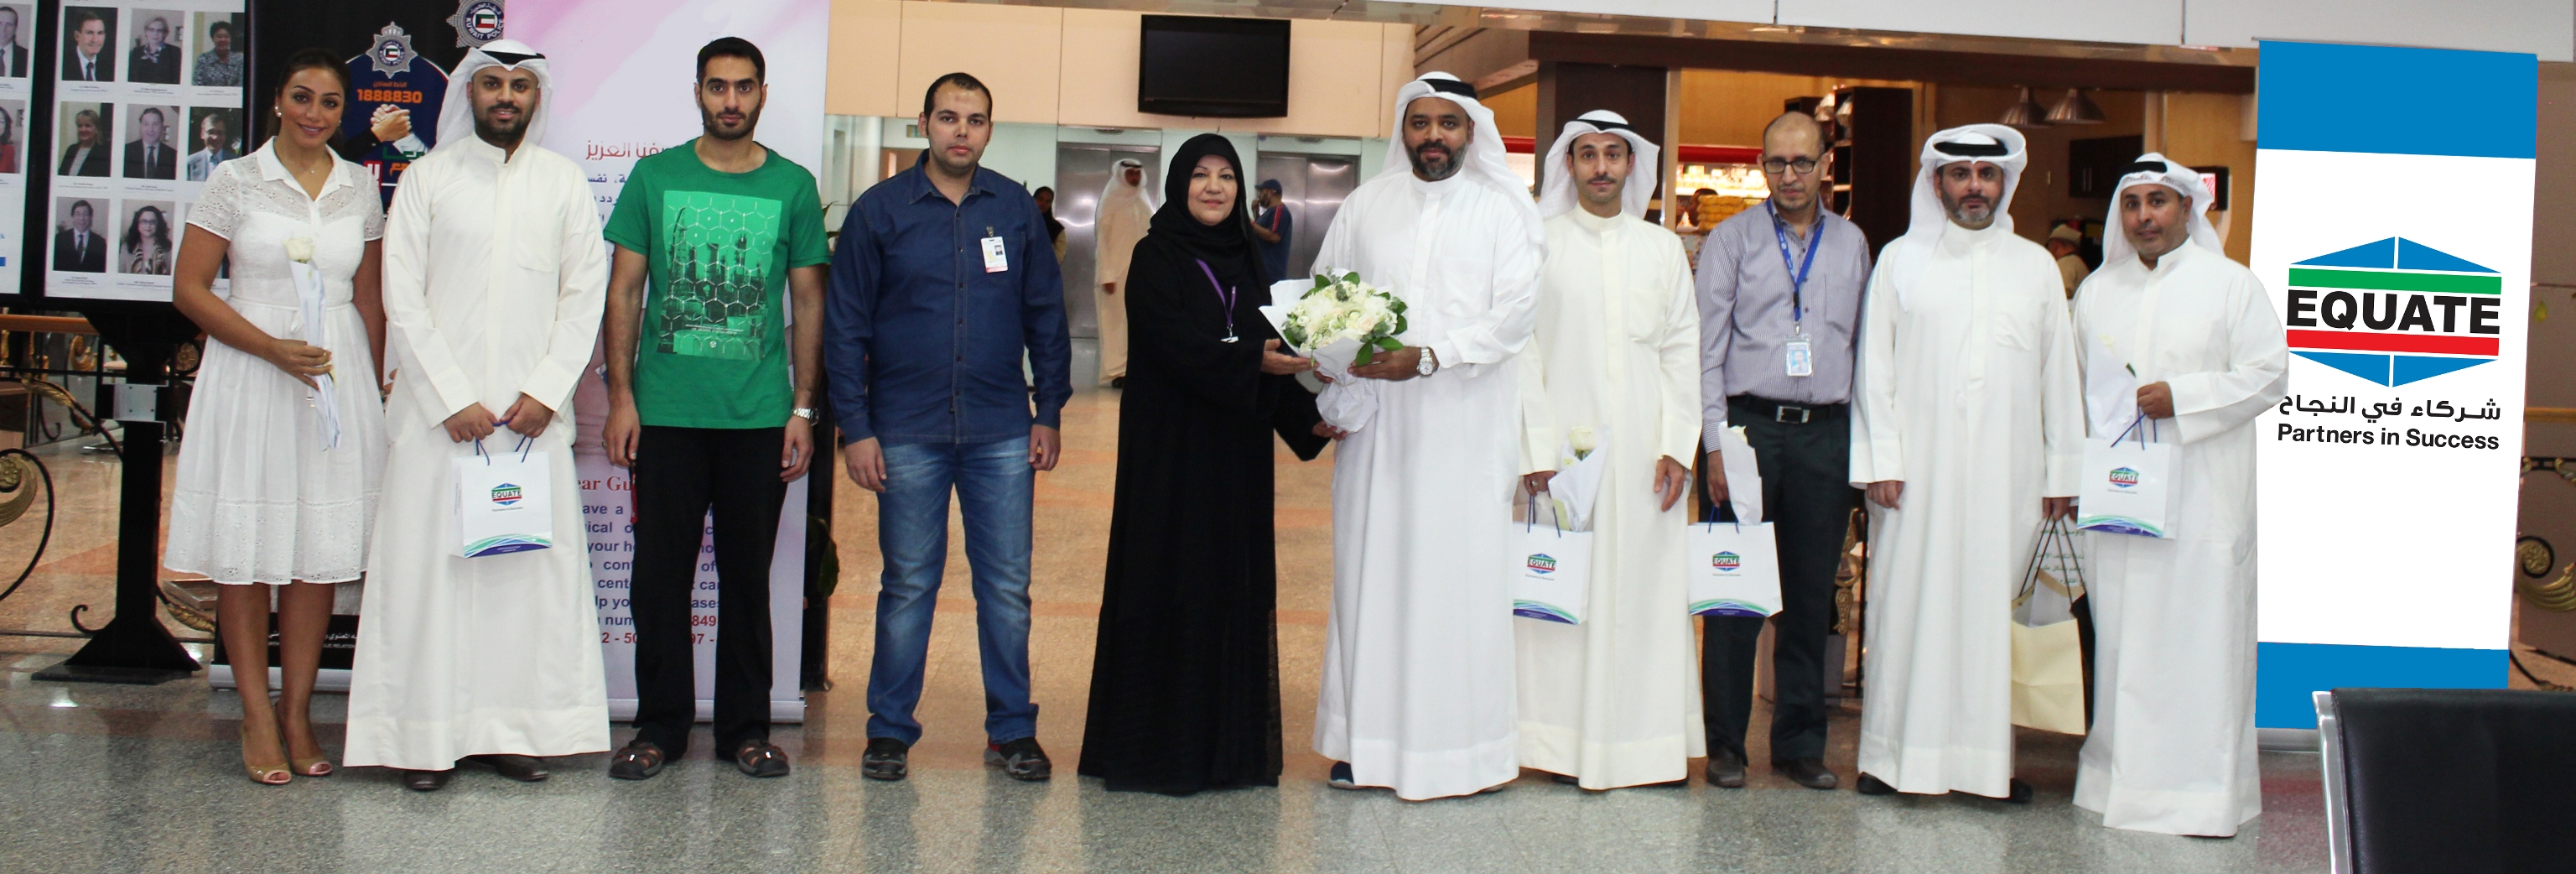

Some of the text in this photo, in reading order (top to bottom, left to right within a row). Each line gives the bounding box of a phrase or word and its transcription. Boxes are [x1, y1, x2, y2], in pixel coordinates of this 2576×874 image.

[465, 17, 485, 39] KUWAIT
[356, 88, 423, 104] 1888830
[585, 139, 631, 161] العزيز
[2286, 289, 2501, 335] EQUATE
[2279, 394, 2501, 423] شركاء في النجاح
[2277, 424, 2500, 450] Partners in Success
[606, 476, 631, 492] Gu
[2109, 473, 2138, 482] EQUATE
[491, 490, 522, 499] EQUATE
[583, 505, 624, 515] ave a
[587, 522, 612, 533] ical
[1527, 559, 1556, 569] EQUATE
[598, 579, 631, 589] cent
